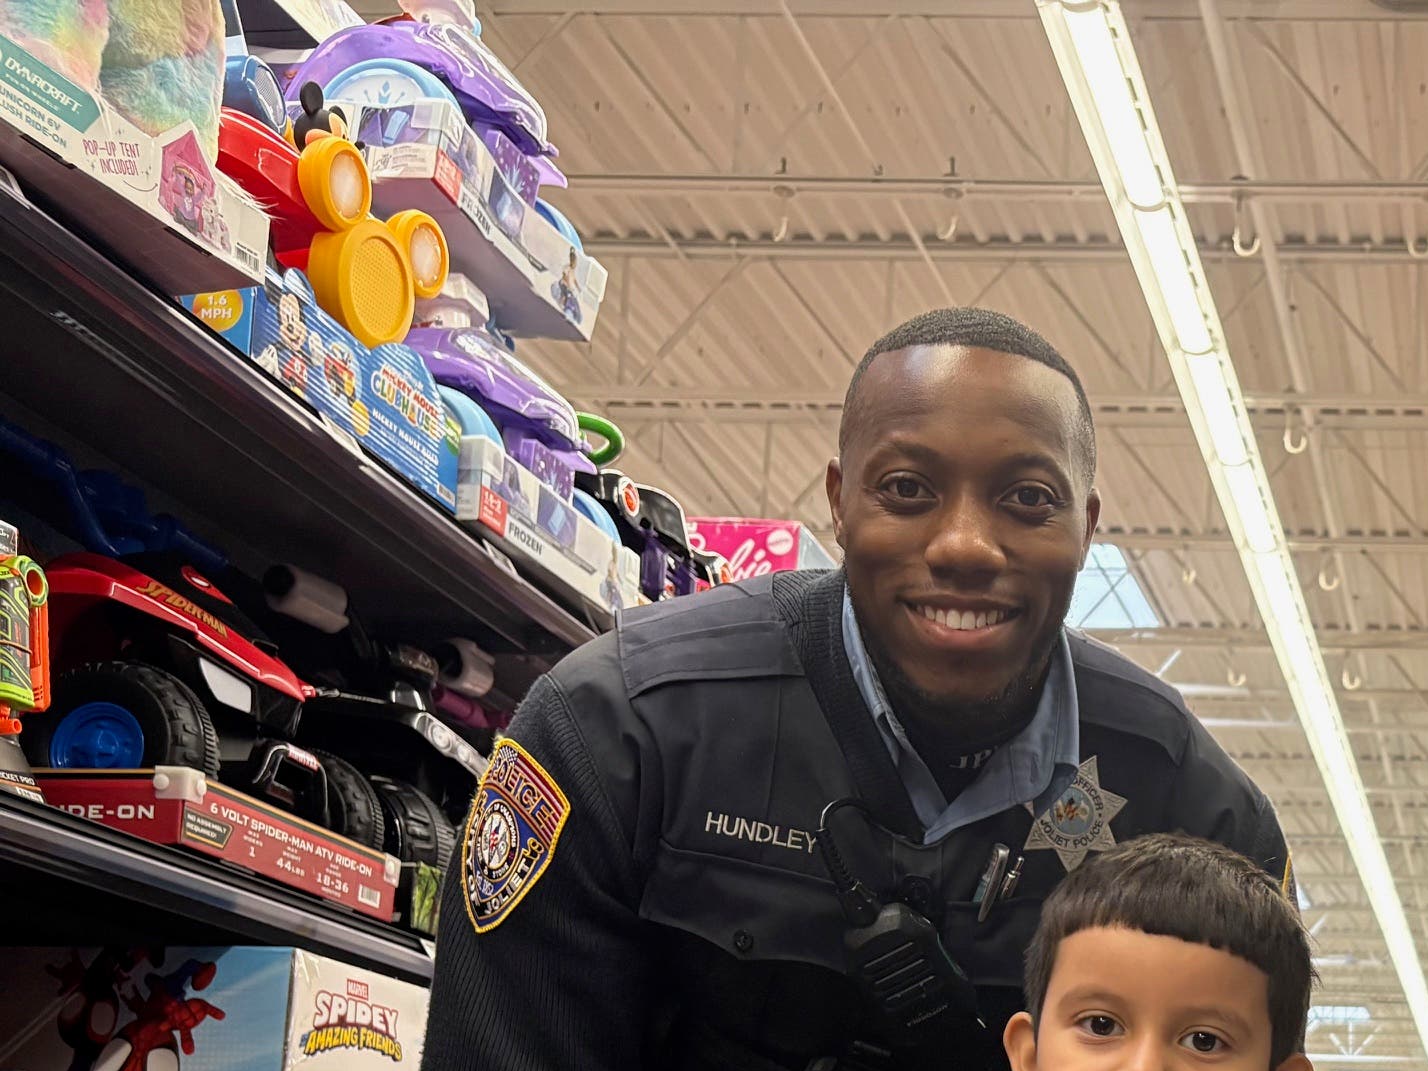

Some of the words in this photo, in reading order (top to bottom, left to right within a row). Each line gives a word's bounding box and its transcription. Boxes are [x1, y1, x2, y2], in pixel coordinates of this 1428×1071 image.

[4, 56, 82, 113] DYNACRAFT
[0, 86, 46, 123] UNICORN
[25, 116, 67, 148] RIDE-ON
[83, 139, 116, 158] POP-UP
[121, 143, 140, 158] TENT
[99, 159, 138, 176] INCLUDED!
[201, 307, 232, 319] MPH
[207, 295, 228, 306] 1.6
[508, 522, 542, 555] FROZEN
[136, 581, 228, 639] SPIDER-MAN
[493, 757, 554, 827] POLICE
[56, 804, 155, 819] IDE-ON
[210, 802, 218, 814] 6
[221, 805, 249, 826] VOLT
[251, 819, 313, 853] SPIDER-MAN
[314, 847, 334, 862] ATV
[335, 855, 372, 877] RIDE-ON
[704, 811, 818, 854] HUNDLEY
[1041, 819, 1069, 848] JOLIET
[1072, 820, 1105, 849] POLICE
[249, 846, 256, 857] 1
[484, 857, 532, 915] JOLIET
[313, 990, 398, 1040] SPIDEY
[304, 1026, 358, 1056] AMAZING
[360, 1026, 402, 1062] FRIENDS
